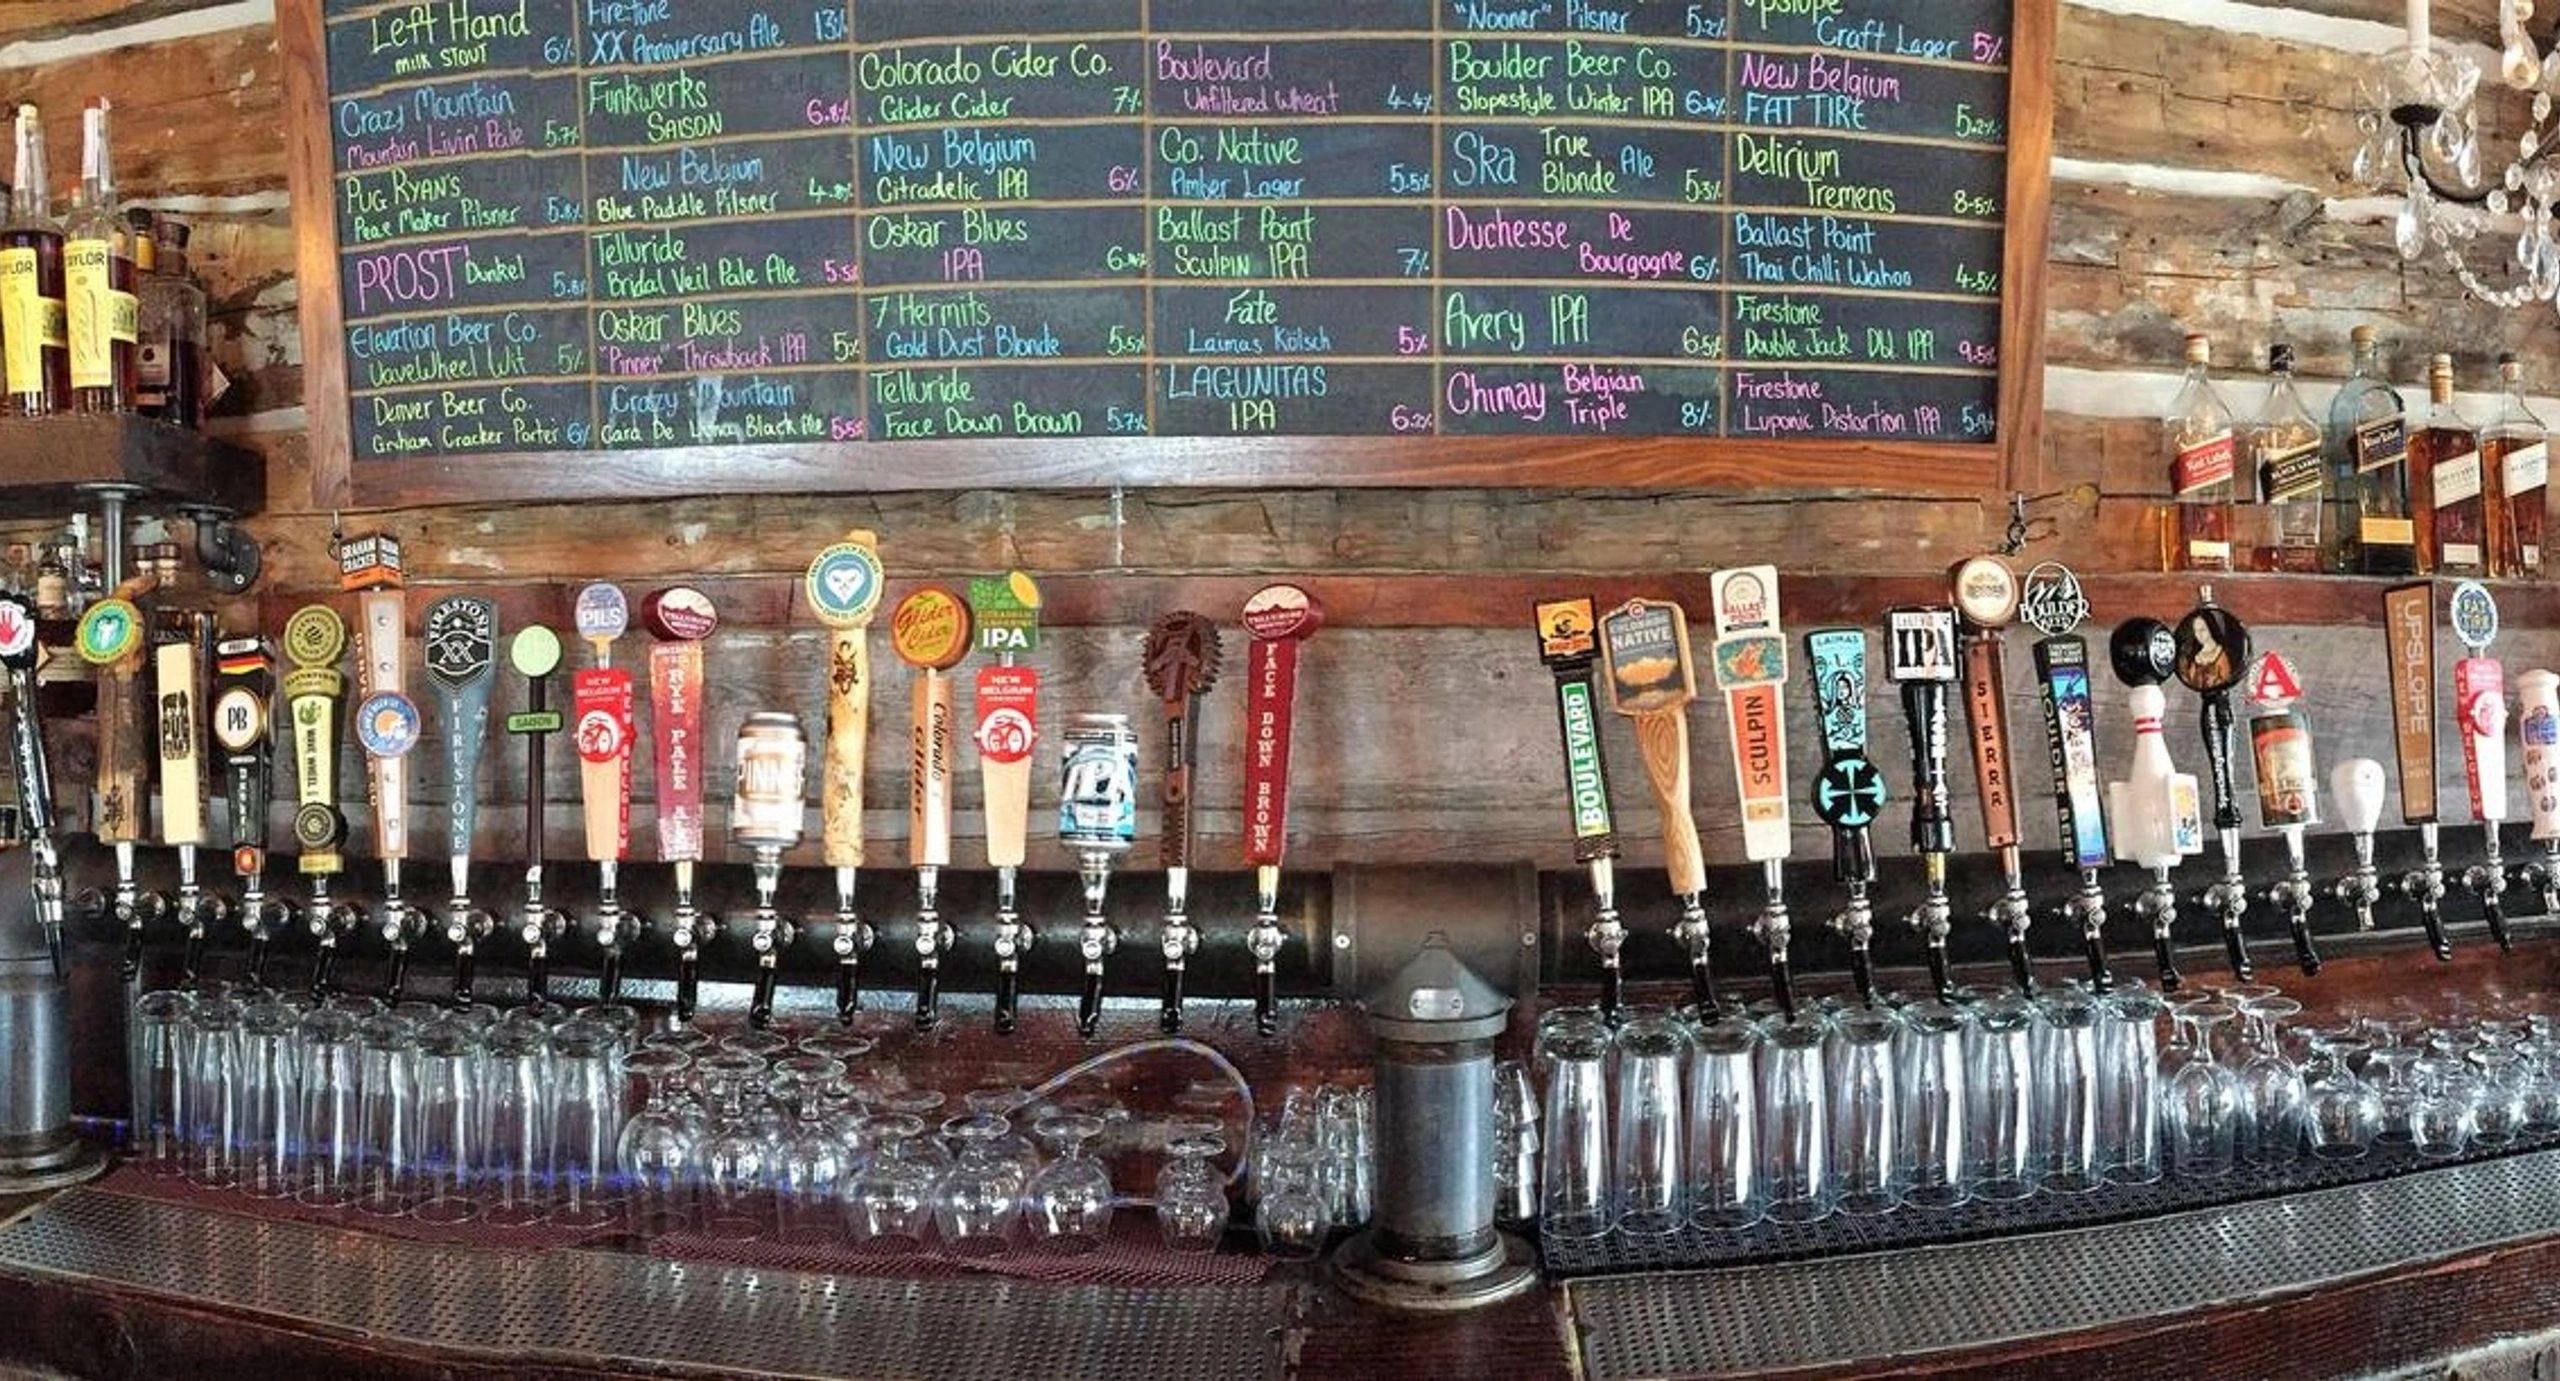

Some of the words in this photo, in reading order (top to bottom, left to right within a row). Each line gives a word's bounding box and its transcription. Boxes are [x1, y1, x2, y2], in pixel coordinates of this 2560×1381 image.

[370, 2, 438, 54] Left
[449, 0, 531, 42] Hand
[1566, 0, 1631, 33] Pilsner
[440, 43, 488, 68] STOUT
[589, 30, 629, 66] XX
[632, 28, 744, 64] Anniversary
[750, 13, 787, 48] Ale
[1816, 16, 1886, 52] Craft
[1896, 24, 1960, 60] Lager
[860, 46, 983, 92] Colorado
[991, 43, 1060, 80] Cider
[1070, 43, 1114, 79] Co.
[1157, 38, 1274, 82] Boulevard
[1450, 41, 1553, 82] Boulder
[1566, 39, 1627, 78] Beer
[1636, 47, 1678, 79] Co.
[1741, 53, 1799, 89] New
[1808, 53, 1900, 103] Belgium
[340, 101, 404, 138] Crazy
[415, 80, 516, 122] Mountain
[588, 67, 709, 116] Funkwerks
[880, 94, 943, 123] Glider
[951, 88, 1015, 120] Cider
[1184, 85, 1269, 115] Unfiltered
[1457, 84, 1557, 116] Slopestyle
[1567, 83, 1634, 113] Winter
[1643, 85, 1675, 117] IPA
[1745, 92, 1802, 125] FAT
[1805, 94, 1868, 130] TIRE
[485, 118, 526, 149] Pale
[873, 134, 931, 174] New
[942, 127, 1037, 176] Belgium
[1216, 126, 1302, 166] Native
[1540, 126, 1593, 158] True
[622, 154, 671, 192] New
[680, 147, 765, 192] Belgium
[1453, 131, 1519, 187] Ska
[1620, 145, 1657, 179] Ale
[1738, 132, 1841, 182] Delirium
[877, 170, 982, 204] Citradelic
[997, 167, 1029, 200] IPA
[1171, 167, 1231, 201] Amber
[1243, 167, 1306, 201] Lager
[1541, 160, 1619, 194] Blonde
[597, 197, 637, 224] Blue
[642, 190, 707, 221] Paddle
[715, 188, 780, 216] Pilsner
[1803, 179, 1896, 213] Tremens
[400, 207, 451, 234] Maker
[460, 198, 522, 228] Pilsner
[868, 215, 948, 250] Oskar
[963, 207, 1029, 245] Blues
[1158, 206, 1245, 242] Ballast
[1260, 206, 1316, 242] Point
[1446, 205, 1572, 252] Duchesse
[1609, 211, 1636, 242] De
[1735, 212, 1817, 250] Ballast
[1823, 216, 1877, 255] Point
[591, 227, 689, 267] Telluride
[1269, 241, 1310, 280] IPA
[1579, 241, 1685, 280] Bourgogne
[465, 254, 526, 285] Dunkel
[608, 266, 667, 298] Bridal
[671, 262, 712, 294] Veil
[718, 257, 760, 287] Pale
[766, 252, 801, 285] Ale
[943, 249, 985, 283] IPA
[1739, 253, 1785, 283] Thai
[1792, 253, 1842, 284] Chilli
[1848, 257, 1913, 288] Wahoo
[598, 308, 672, 344] Oskar
[682, 302, 743, 339] Blues
[869, 295, 891, 330] 7
[898, 291, 992, 328] Hermits
[1225, 289, 1279, 325] Fate
[1445, 291, 1526, 352] Avery
[1550, 294, 1591, 346] IPA
[1736, 295, 1824, 325] Firestone
[351, 318, 437, 358] Elevation
[447, 314, 497, 347] Beer
[678, 335, 774, 372] Throwback
[780, 331, 808, 365] IPA
[885, 328, 928, 359] Gold
[938, 327, 986, 358] Dust
[994, 322, 1063, 358] Blonde
[1188, 327, 1263, 354] Laimas
[1745, 328, 1803, 358] Double
[1804, 326, 1853, 357] Jack
[488, 346, 528, 380] Wit
[1168, 363, 1328, 400] LAGUNITAS
[1564, 363, 1645, 400] Belgian
[870, 367, 976, 404] Telluride
[1447, 371, 1547, 422] Chimay
[1736, 371, 1824, 400] Firestone
[374, 397, 435, 427] Denver
[441, 391, 488, 418] Beer
[745, 412, 798, 438] Black
[885, 411, 937, 439] Face
[945, 406, 1004, 435] Down
[1013, 400, 1083, 435] Brown
[1231, 399, 1277, 431] IPA
[1563, 399, 1630, 432] Triple
[1744, 404, 1815, 437] Luponic
[1821, 400, 1907, 433] Distortion
[1913, 406, 1941, 435] IPA
[372, 429, 434, 454] Graham
[442, 422, 505, 449] Cracker
[512, 417, 561, 445] Porter
[429, 599, 491, 641] FIRESTONE
[582, 606, 622, 625] PILS
[2020, 600, 2092, 624] BOULDER
[983, 628, 1029, 648] IPA
[1611, 626, 1672, 651] NATIVE
[1263, 642, 1279, 699] FACE
[2404, 599, 2429, 736] UPSLOPE
[668, 668, 685, 715] RYE
[227, 706, 247, 731] PB
[1256, 711, 1277, 769] DOWN
[1745, 694, 1772, 786] SCULPIN
[2039, 681, 2063, 796] BOULDER
[670, 729, 688, 791] PALE
[1567, 692, 1602, 828] BOULEVARD
[1253, 780, 1274, 852] BROWN
